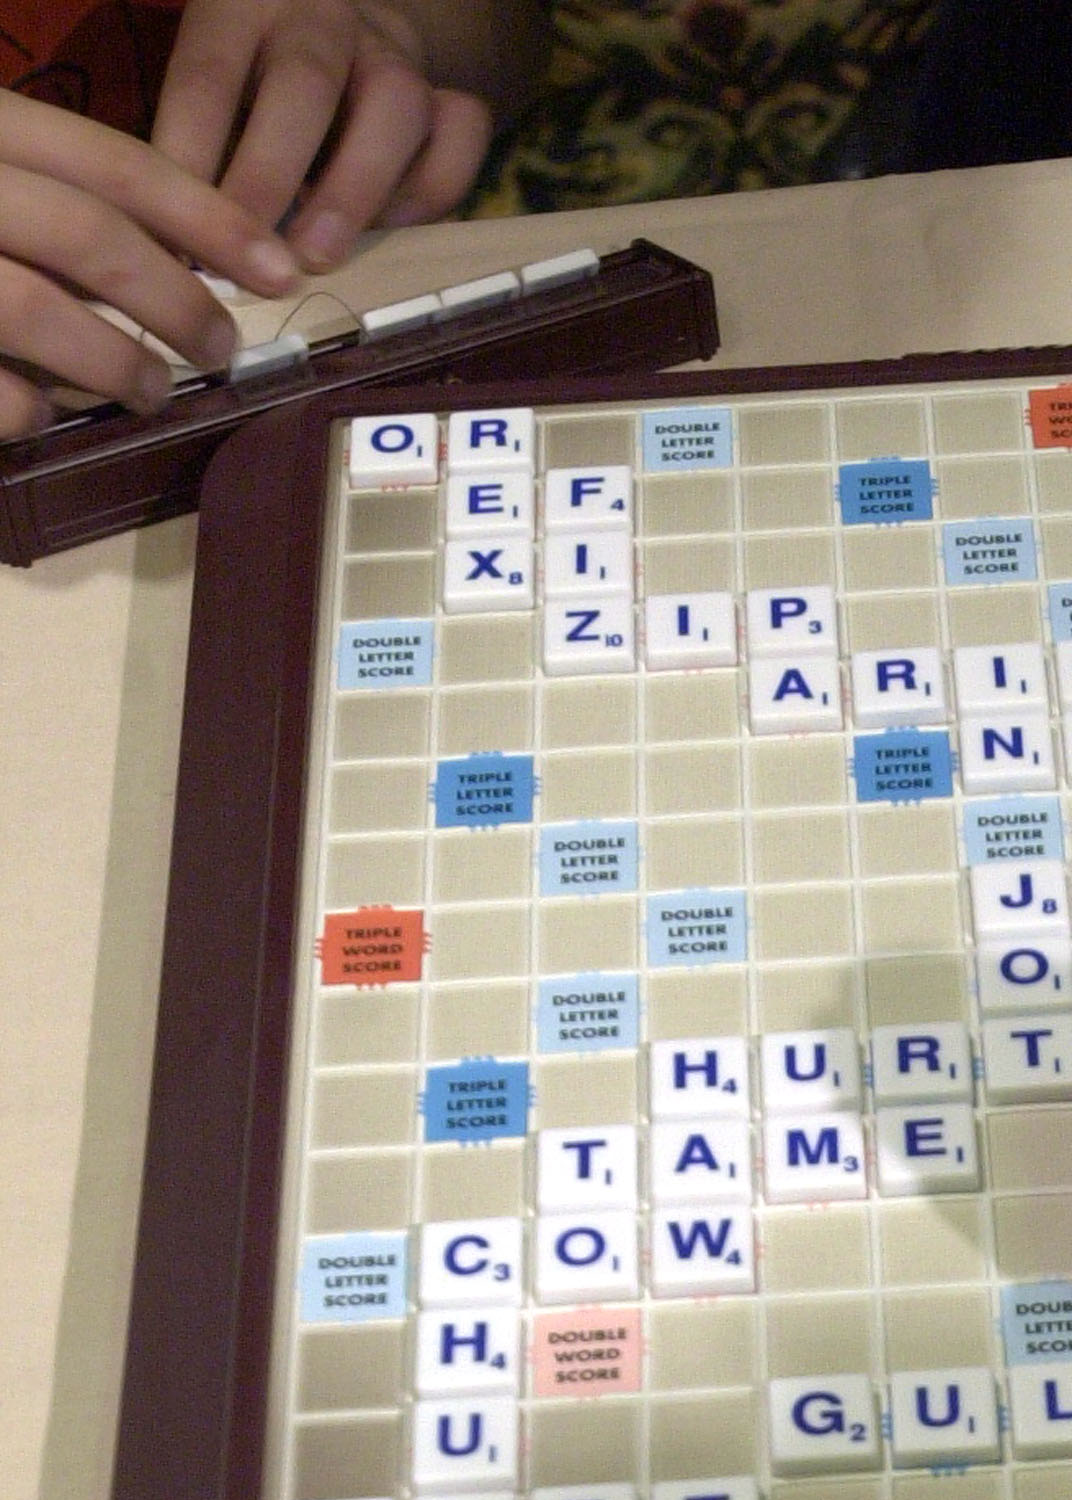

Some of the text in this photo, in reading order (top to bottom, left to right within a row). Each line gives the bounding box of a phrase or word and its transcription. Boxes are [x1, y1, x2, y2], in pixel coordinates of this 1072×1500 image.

[654, 422, 720, 435] DOUBLE
[661, 436, 715, 448] LETTER
[661, 450, 715, 462] SCORE
[860, 475, 911, 487] TRIPLE
[859, 489, 913, 501] LETTER
[860, 502, 914, 514] SCORE
[955, 533, 1022, 547] DOUBLE
[962, 548, 1017, 561] LETTER
[963, 562, 1019, 575] SCORE
[352, 636, 422, 649] DOUBLE
[358, 651, 414, 664] LETTER
[357, 666, 414, 678] SCORE
[875, 746, 930, 760] TRIPLE
[874, 762, 932, 776] LETTER
[458, 771, 513, 785] TRIPLE
[875, 777, 933, 791] SCORE
[456, 787, 514, 801] LETTER
[455, 802, 513, 816] SCORE
[977, 812, 1048, 828] DOUBLE
[985, 828, 1043, 843] LETTER
[553, 837, 625, 853] DOUBLE
[986, 844, 1045, 859] SCORE
[560, 854, 619, 868] LETTER
[560, 870, 619, 884] SCORE
[660, 906, 733, 922] DOUBLE
[346, 926, 403, 940] TRIPLE
[667, 924, 727, 938] LETTER
[341, 943, 404, 957] WORD
[668, 941, 728, 955] SCORE
[342, 960, 402, 973] SCORE
[552, 991, 626, 1007] DOUBLE
[559, 1008, 619, 1023] LETTER
[558, 1025, 619, 1041] SCORE
[448, 1079, 507, 1094] TRIPLE
[446, 1097, 507, 1112] LETTER
[446, 1114, 507, 1127] SCORE
[317, 1253, 397, 1270] DOUBLE
[324, 1273, 389, 1289] LETTER
[323, 1291, 389, 1308] SCORE
[547, 1328, 627, 1345] DOUBLE
[554, 1347, 621, 1364] WORD
[555, 1367, 621, 1384] SCORE
